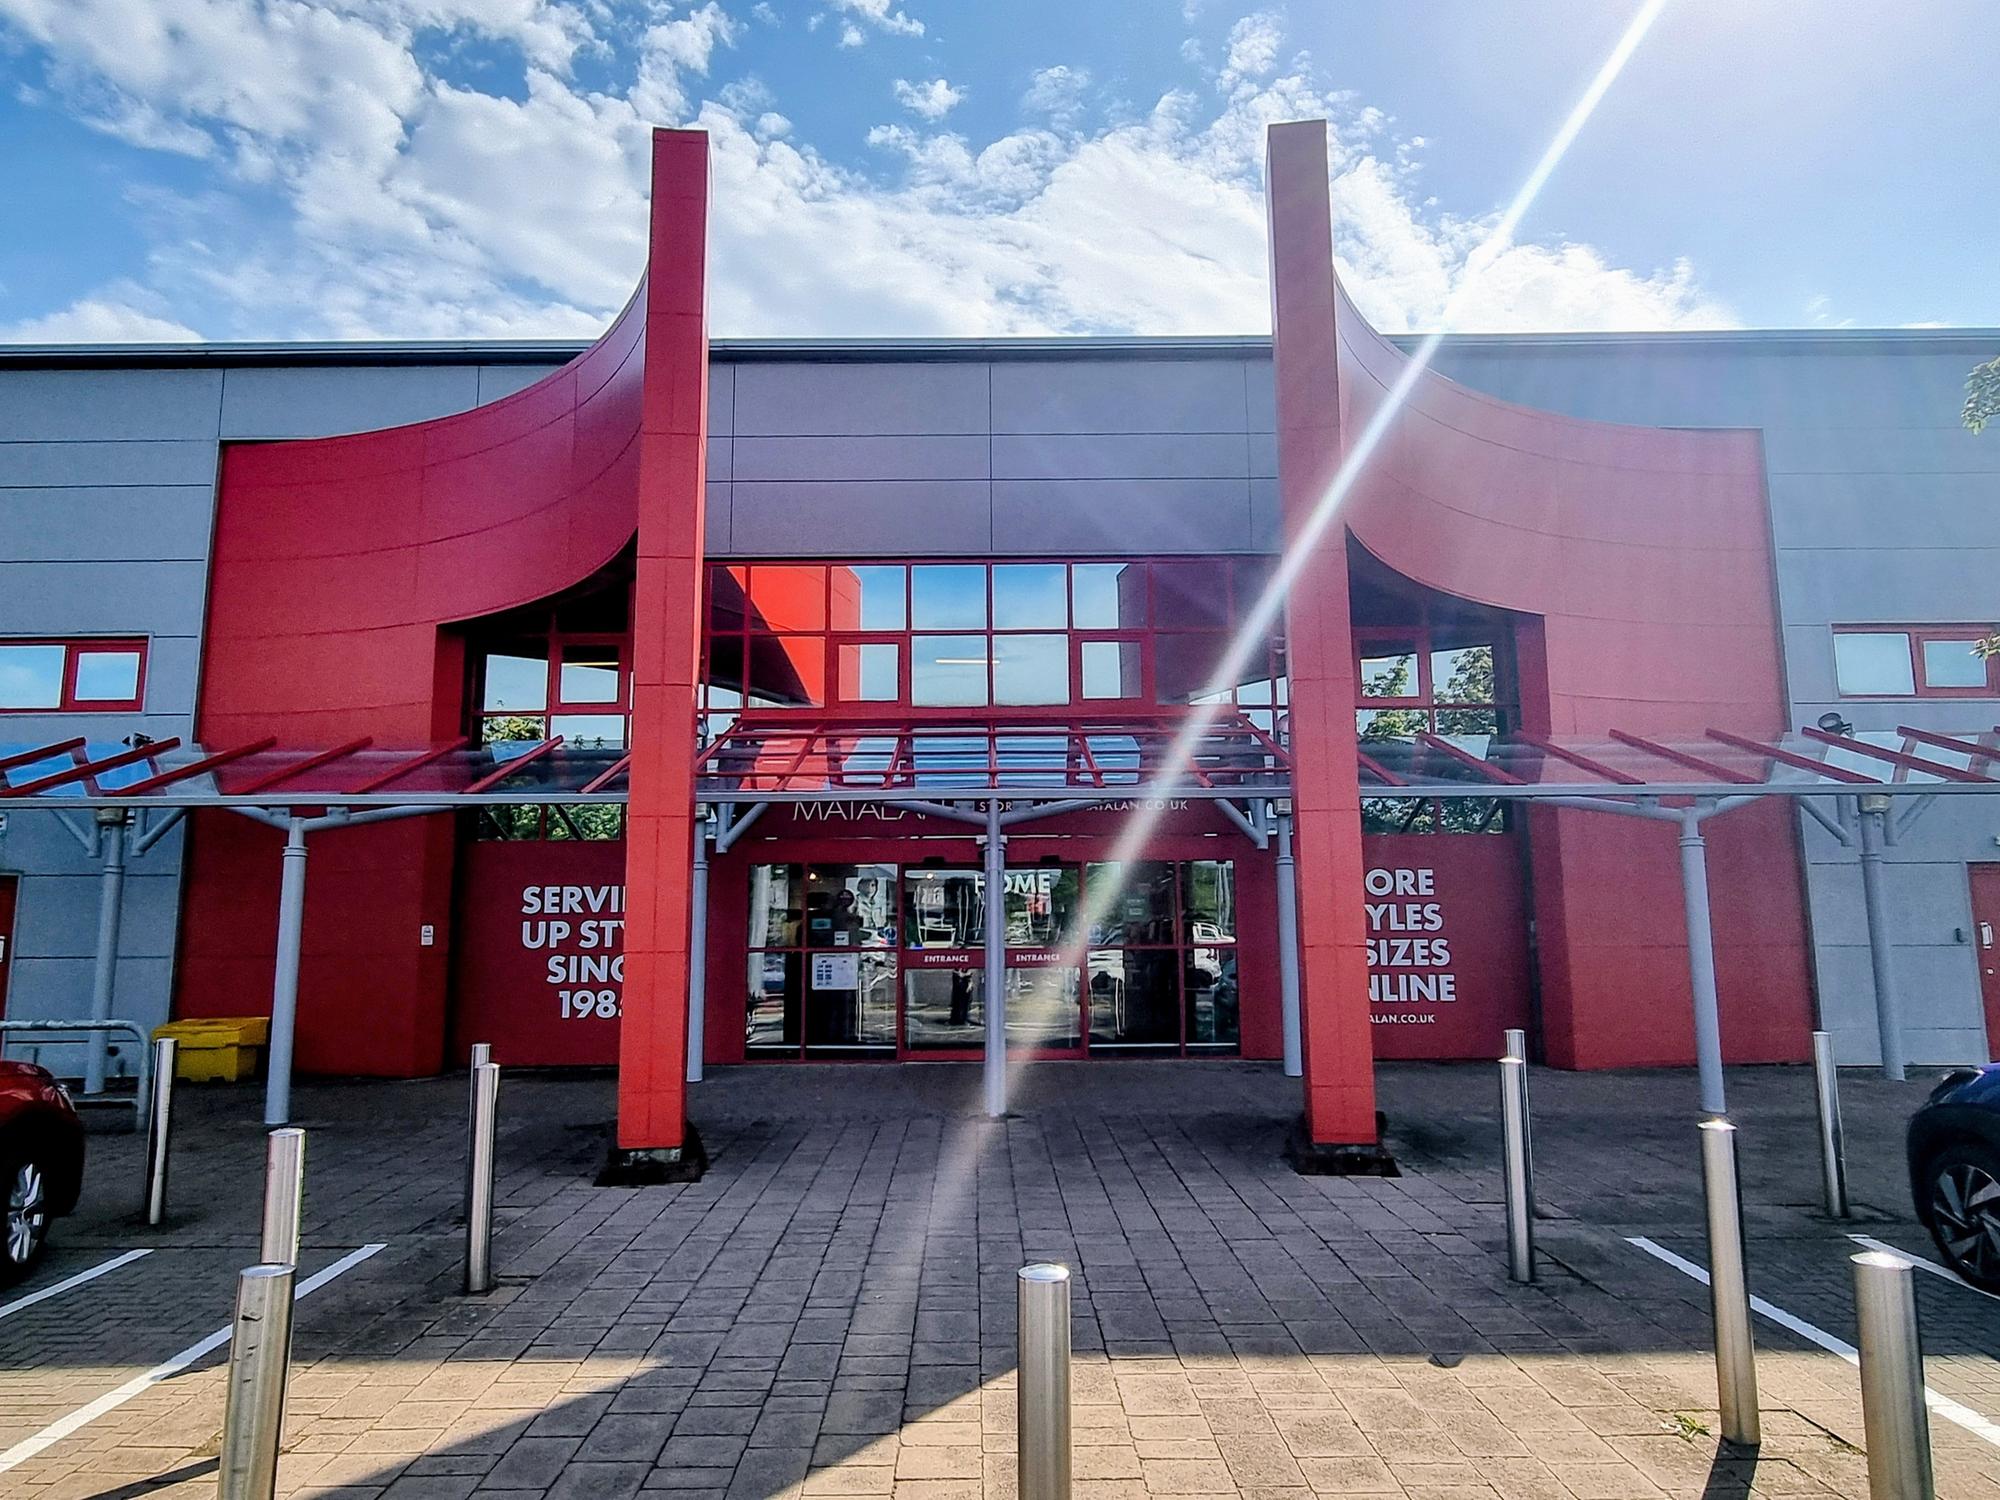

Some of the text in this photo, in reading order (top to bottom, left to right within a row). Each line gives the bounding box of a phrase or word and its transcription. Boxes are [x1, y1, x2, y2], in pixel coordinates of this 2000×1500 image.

[1365, 868, 1435, 896] ORE
[521, 886, 625, 914] SERVI
[1364, 904, 1443, 932] YLES
[522, 920, 625, 949] UP ST
[924, 954, 1060, 963] ENTRANCE ENTRANCE
[1366, 938, 1450, 967] SIZES
[559, 990, 623, 1019] 198
[1369, 1014, 1436, 1024] ALAN.CO.UK
